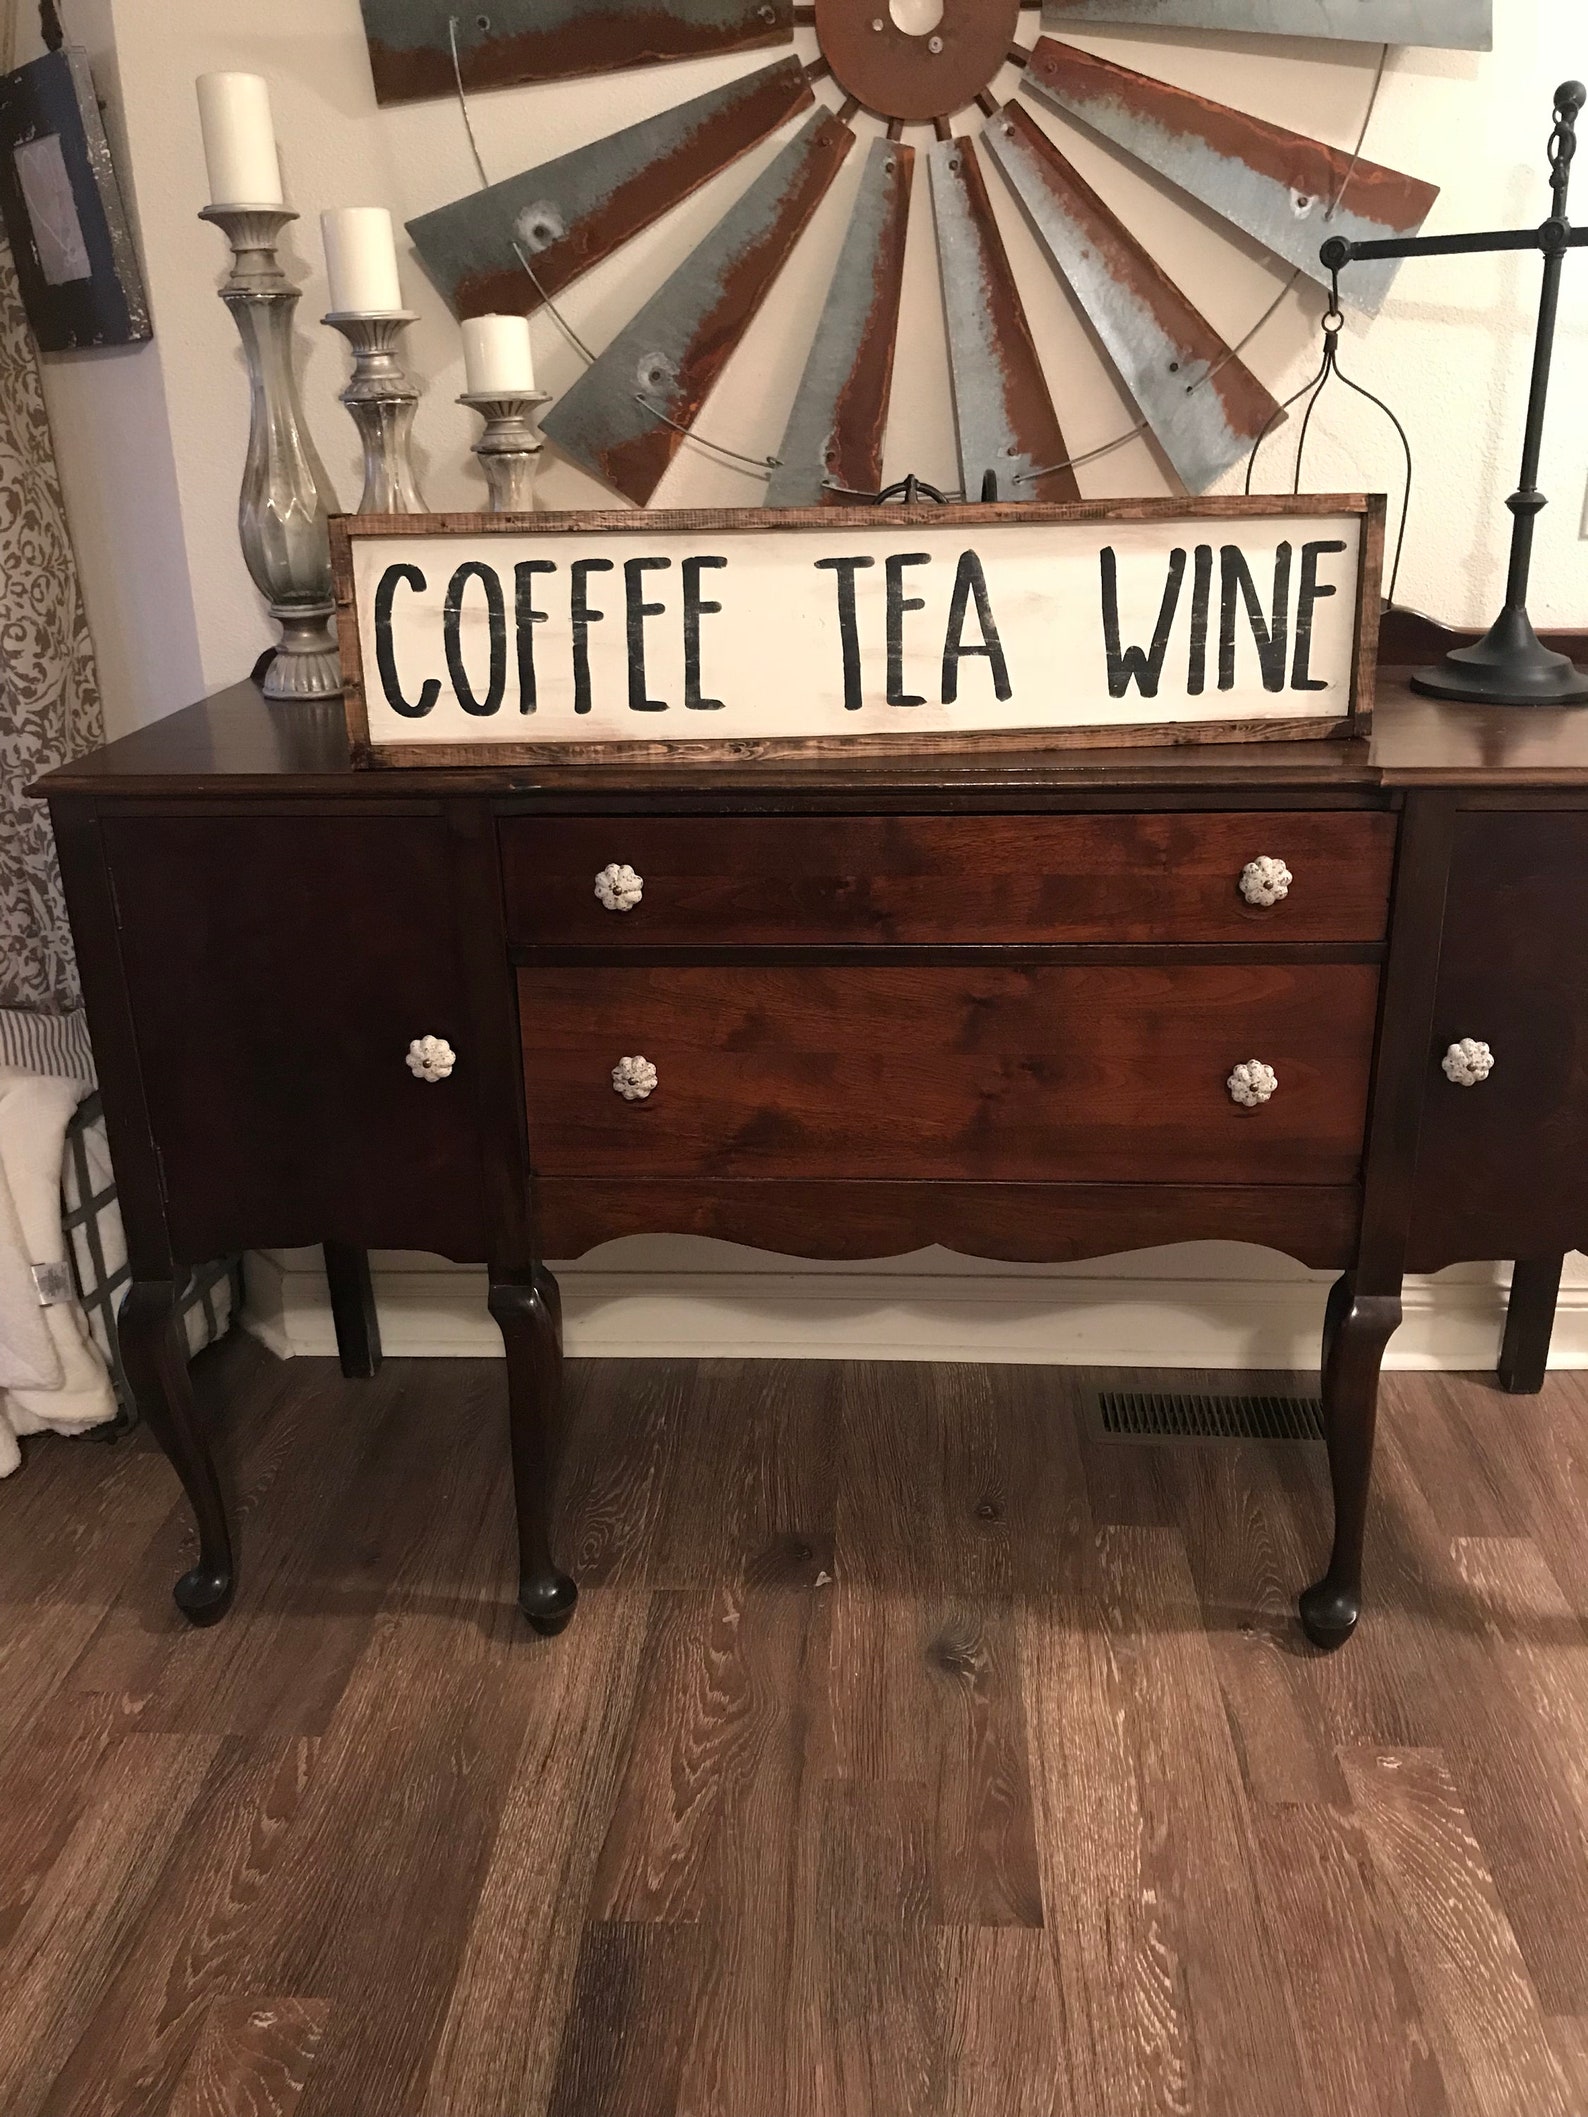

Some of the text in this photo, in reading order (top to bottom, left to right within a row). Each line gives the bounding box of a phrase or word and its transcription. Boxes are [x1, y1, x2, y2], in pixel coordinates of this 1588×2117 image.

[374, 540, 1347, 719] COFFEE TEA WINE
